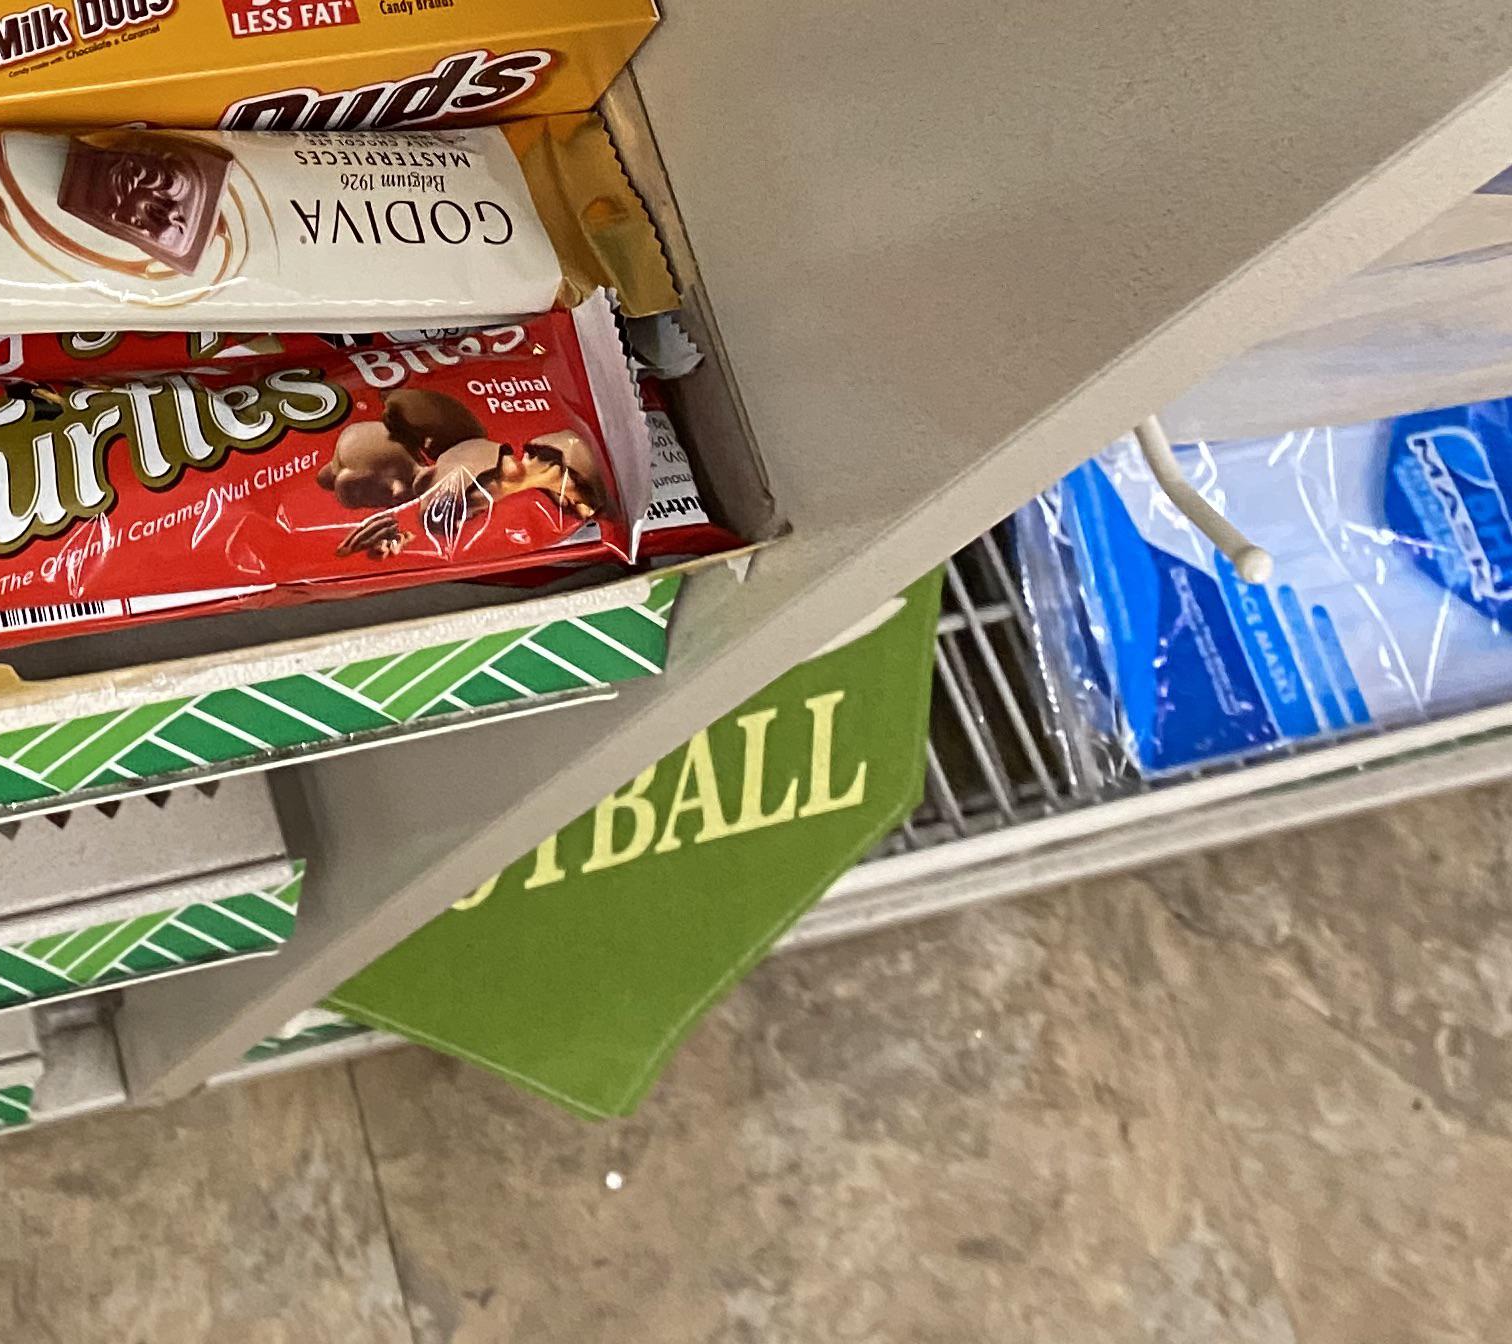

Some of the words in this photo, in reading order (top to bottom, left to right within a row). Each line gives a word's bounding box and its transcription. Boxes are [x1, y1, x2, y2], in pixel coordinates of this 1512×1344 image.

[379, 0, 414, 17] Candy
[231, 8, 293, 37] LESS
[65, 39, 112, 61] Chocolate
[120, 23, 161, 44] Caramel
[294, 150, 472, 169] MASTERPIECES
[340, 172, 375, 191] 1926
[381, 173, 445, 194] Belgium
[290, 199, 514, 246] GODIVA
[466, 374, 552, 400] Original
[486, 395, 552, 414] Pecan
[0, 568, 34, 596] The
[219, 478, 251, 508] Nut
[253, 449, 321, 492] Cluster
[1232, 574, 1263, 628] ACE
[451, 689, 868, 912] BALL
